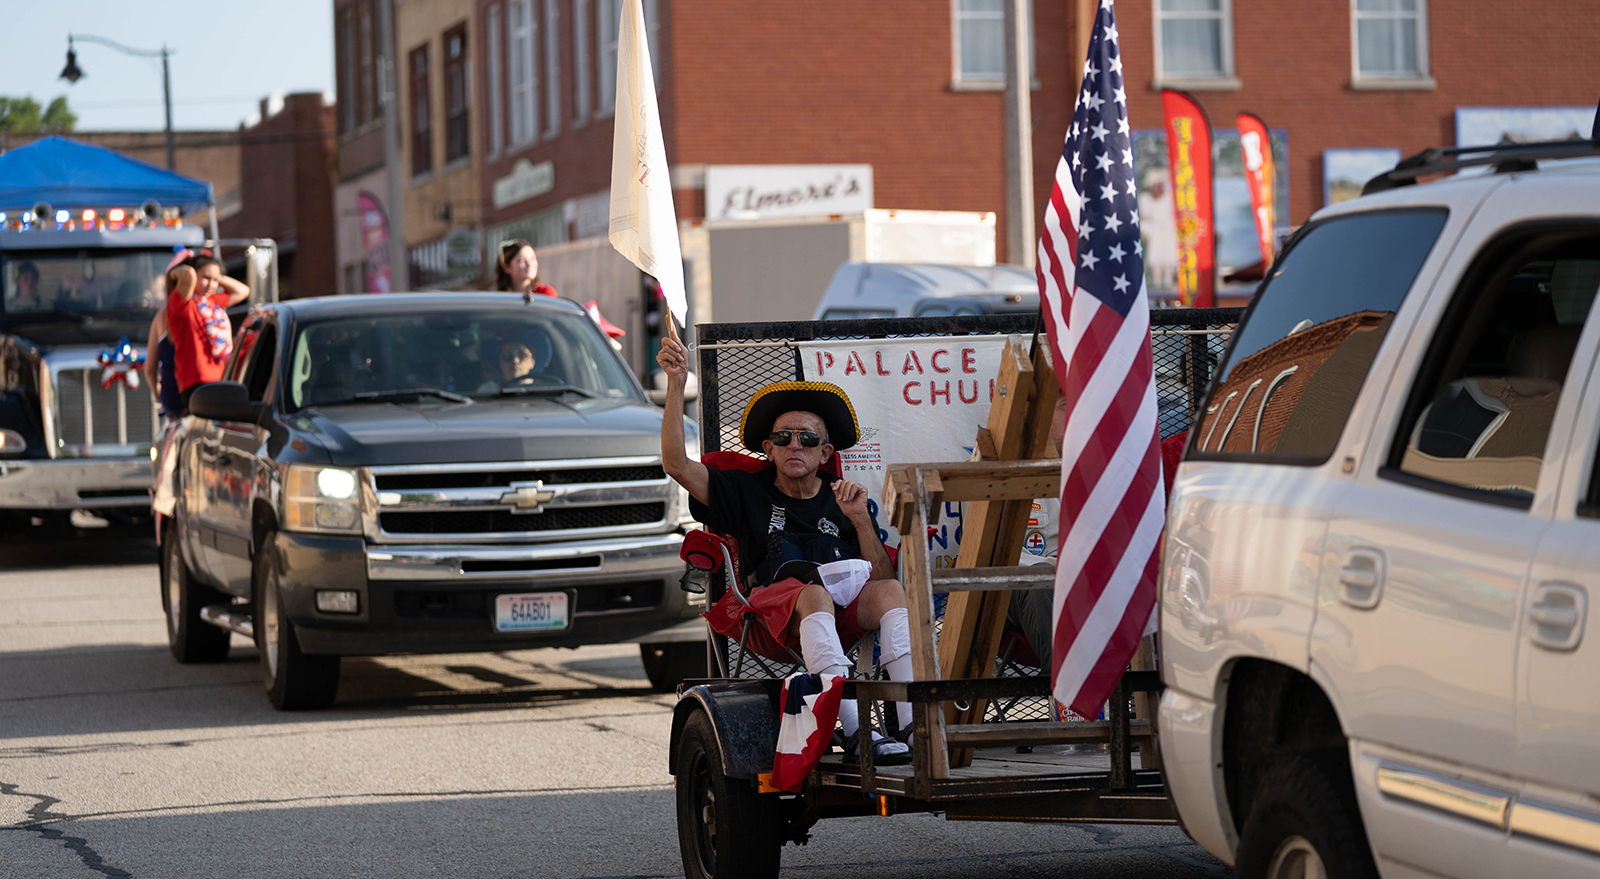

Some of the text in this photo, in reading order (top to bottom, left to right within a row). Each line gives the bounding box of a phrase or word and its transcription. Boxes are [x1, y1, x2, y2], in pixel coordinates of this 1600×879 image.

[721, 176, 860, 217] Elmore's
[815, 347, 978, 378] PALACE
[511, 602, 551, 621] 64AB01
